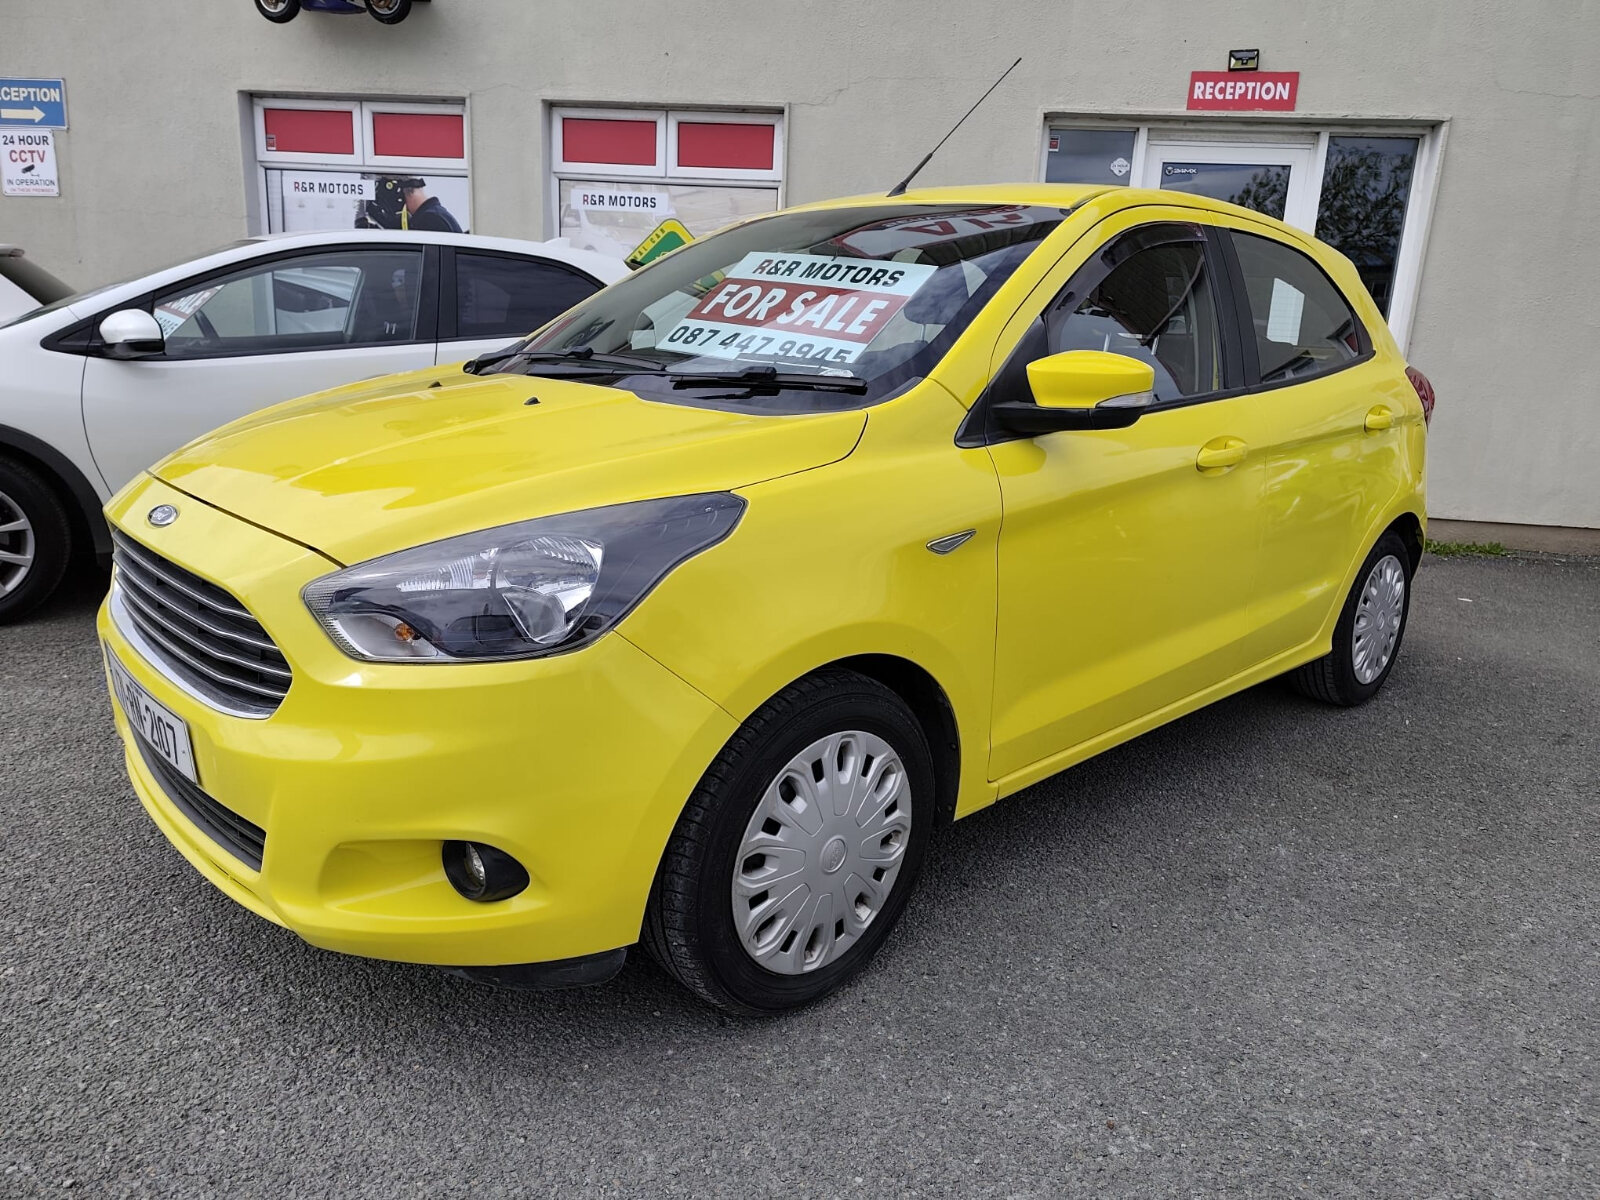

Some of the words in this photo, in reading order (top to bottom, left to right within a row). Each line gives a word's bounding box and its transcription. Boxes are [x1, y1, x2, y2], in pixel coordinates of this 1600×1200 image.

[0, 87, 60, 102] CEPTION
[1192, 81, 1291, 101] RECEPTION
[2, 135, 15, 145] 24
[18, 135, 49, 146] HOUR
[9, 150, 46, 163] CCTV
[293, 181, 315, 193] R&R
[318, 182, 364, 195] MOTORS
[582, 194, 605, 206] R&R
[608, 195, 657, 208] MOTORS
[649, 228, 666, 244] CAR
[751, 259, 802, 279] R&R
[801, 261, 906, 288] MOTORS
[700, 284, 788, 321] FOR
[776, 291, 889, 335] SALE
[667, 325, 723, 346] 087
[718, 331, 775, 354] 447
[774, 340, 853, 363] 9945
